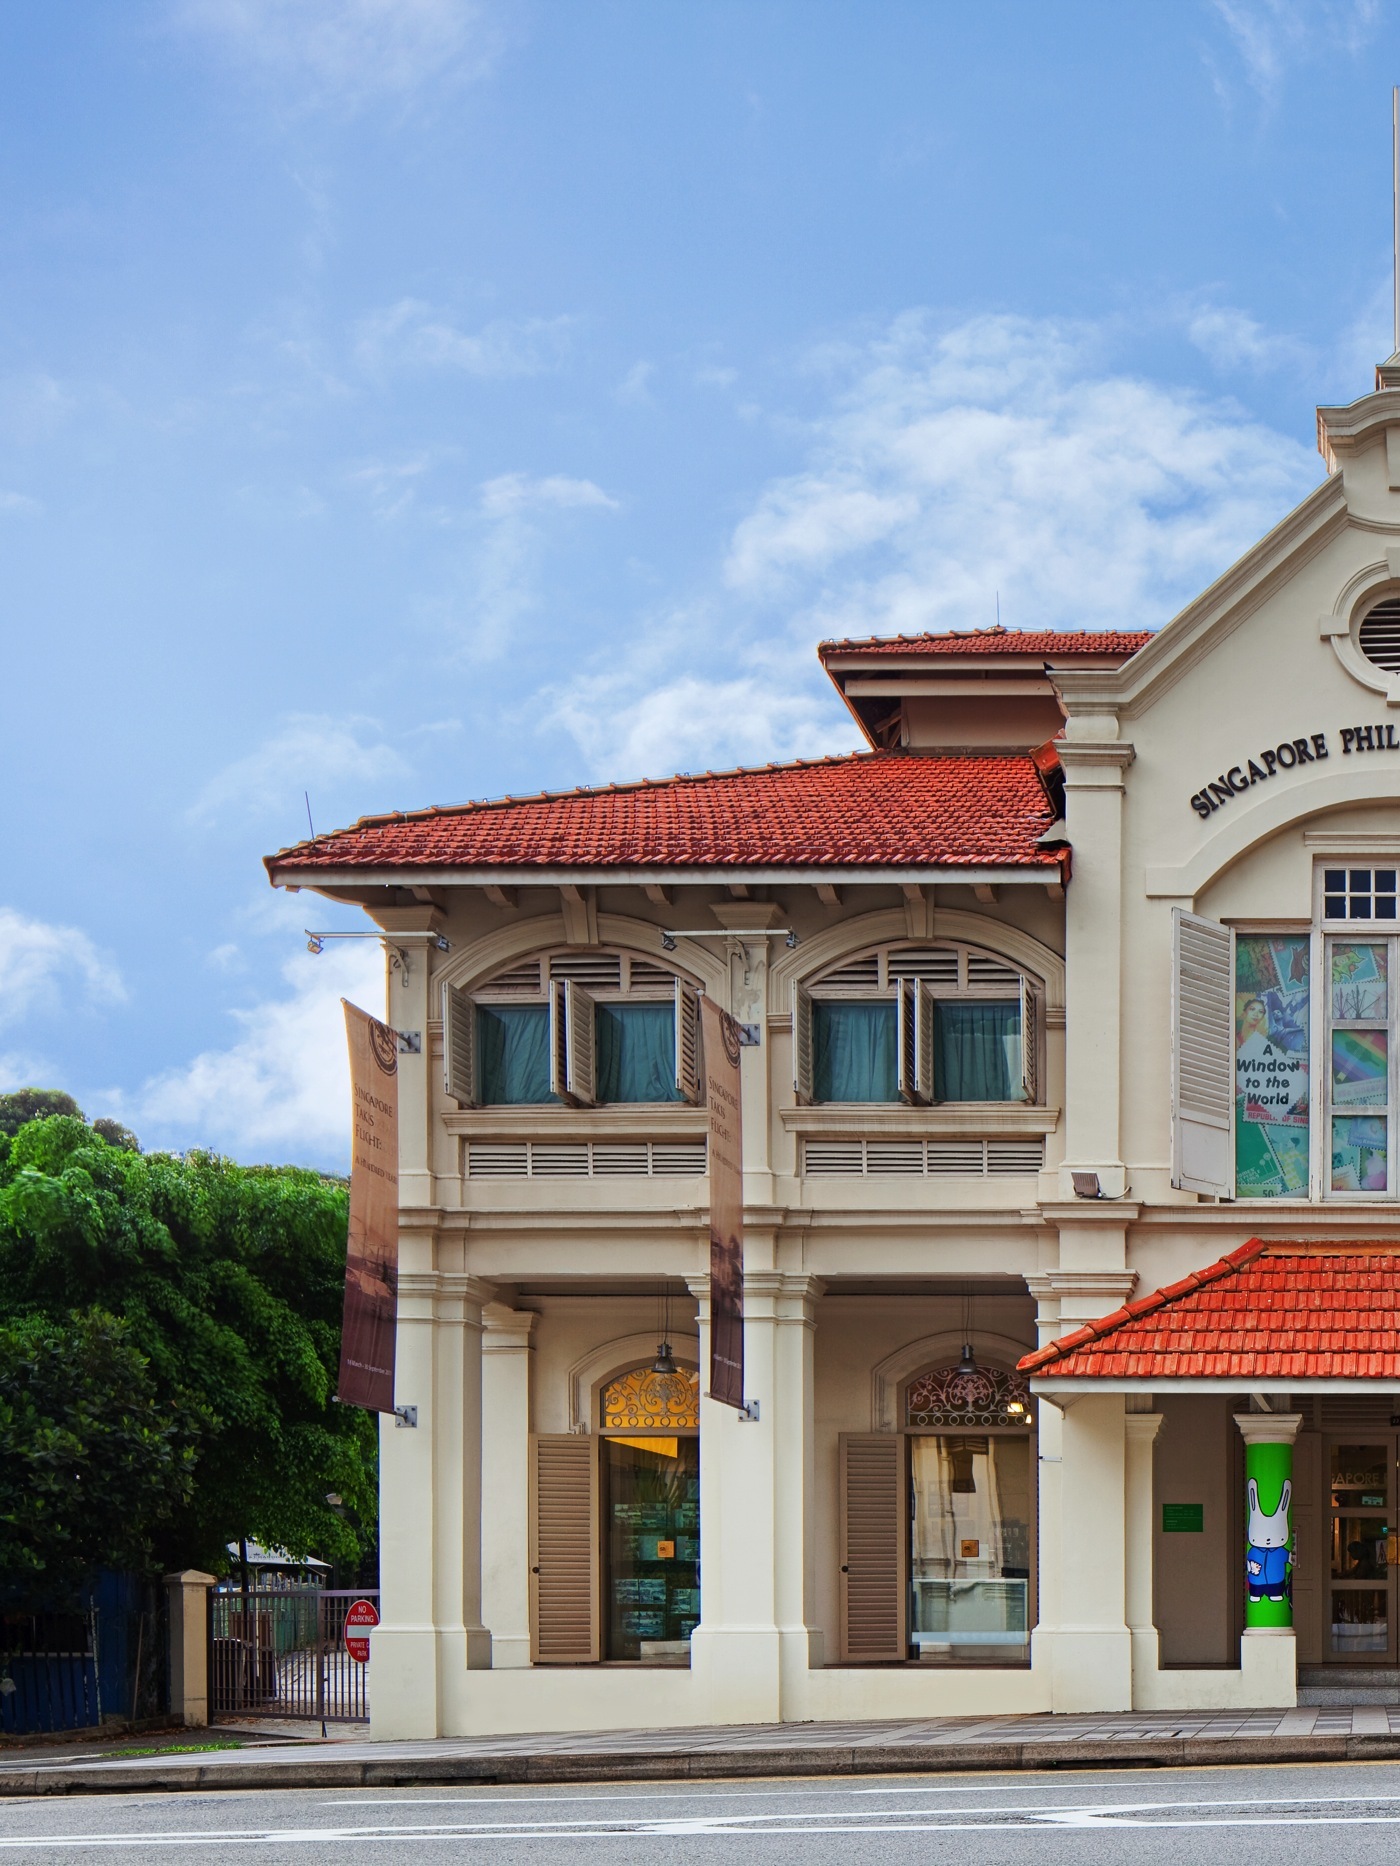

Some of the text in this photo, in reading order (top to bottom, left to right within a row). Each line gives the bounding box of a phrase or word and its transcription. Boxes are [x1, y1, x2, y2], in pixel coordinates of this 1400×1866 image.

[1190, 733, 1329, 819] SINGAPORE
[1263, 1044, 1273, 1056] A
[1237, 1059, 1299, 1073] Window
[1246, 1076, 1290, 1089] to the
[709, 1076, 738, 1110] SINGAPORE
[1247, 1092, 1289, 1105] World
[355, 1083, 393, 1118] SINGAPORE
[710, 1096, 726, 1119] TAKS
[355, 1103, 374, 1127] TAKS
[1248, 1112, 1278, 1122] REPUBL
[358, 1606, 367, 1614] NO
[351, 1615, 374, 1623] PARKING
